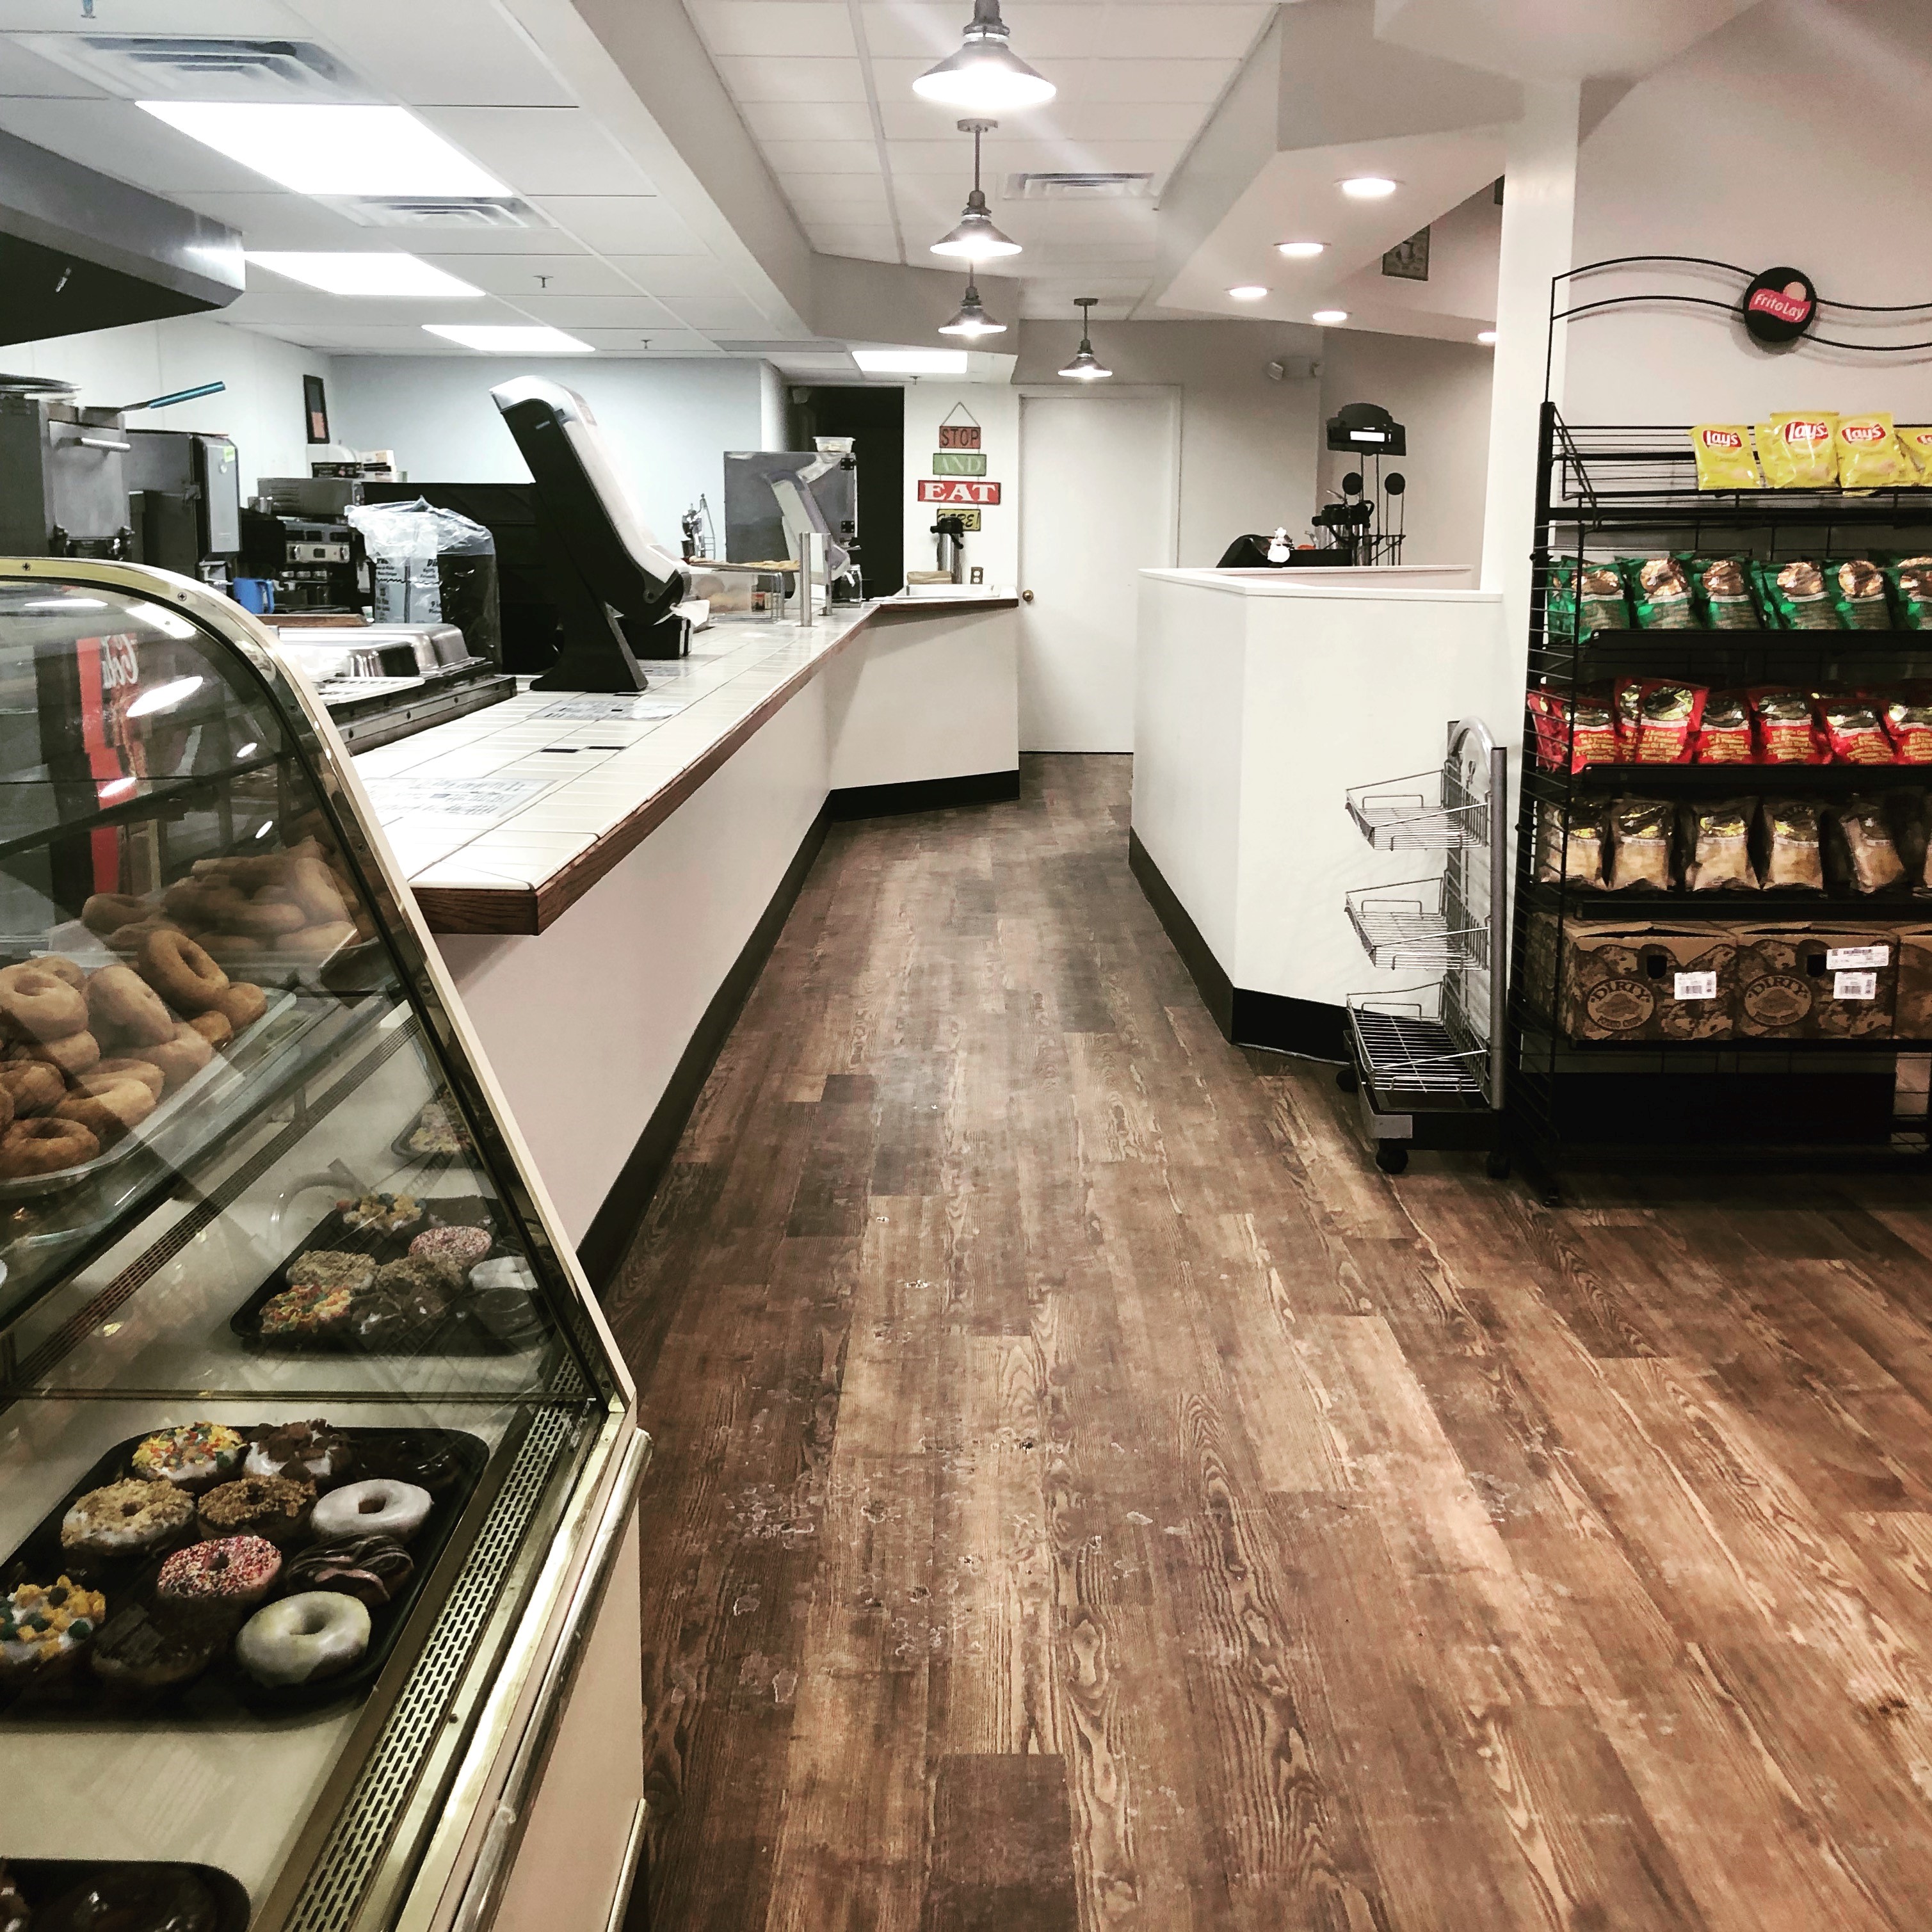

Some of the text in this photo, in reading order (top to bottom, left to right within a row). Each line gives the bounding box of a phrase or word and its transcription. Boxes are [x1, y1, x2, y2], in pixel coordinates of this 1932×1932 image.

[941, 428, 979, 446] STOP
[939, 456, 981, 472] AND
[923, 482, 996, 502] EAT
[937, 513, 980, 529] RE!
[1592, 981, 1648, 1001] DIRTY
[1750, 976, 1808, 997] DIRTY
